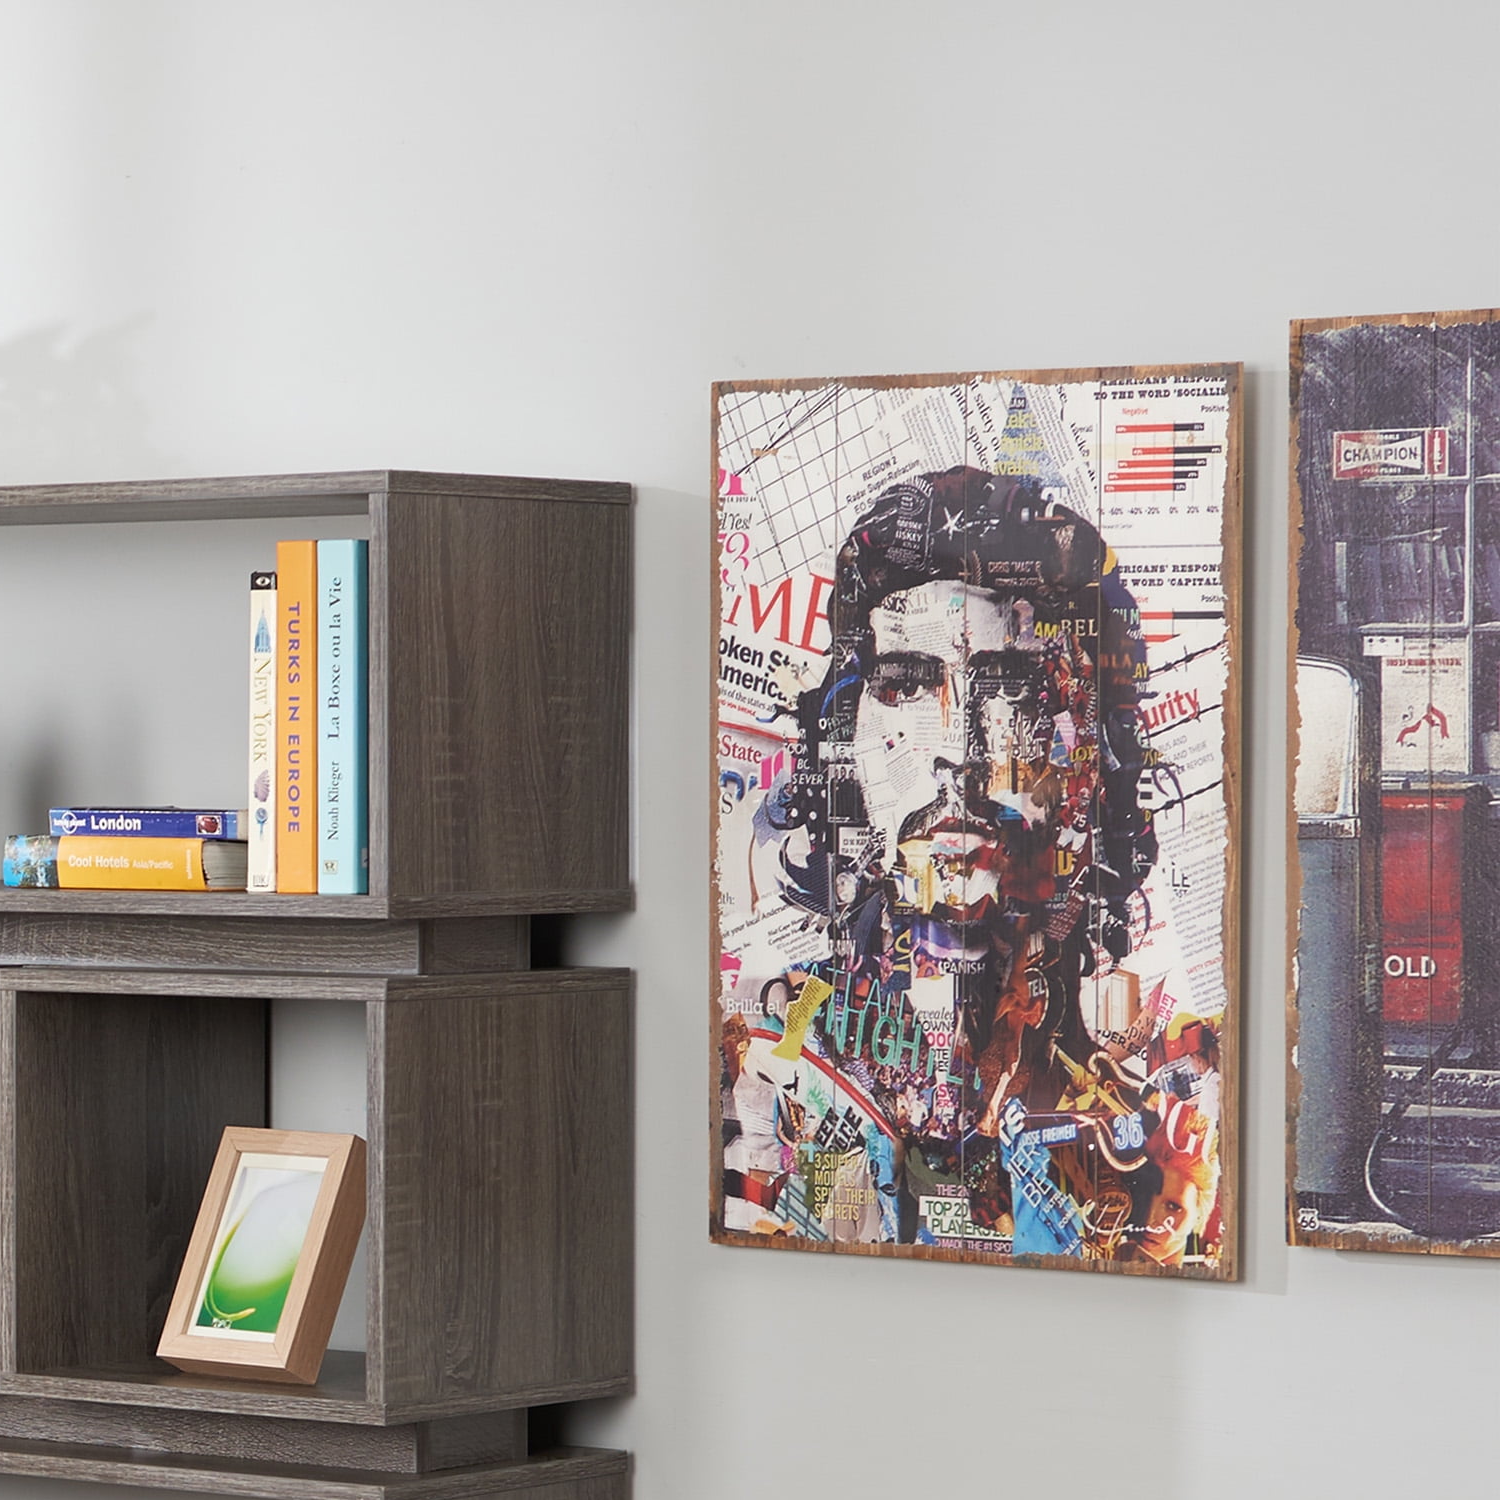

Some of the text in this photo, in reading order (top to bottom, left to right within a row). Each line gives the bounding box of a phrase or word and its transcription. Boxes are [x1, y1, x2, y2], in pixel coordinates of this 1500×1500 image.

[1093, 392, 1108, 400] TO
[1111, 391, 1134, 400] THE
[1138, 389, 1170, 398] WORD
[1343, 447, 1418, 462] CHAMPION
[862, 460, 891, 481] REGION
[1132, 578, 1164, 586] WORD
[328, 577, 342, 739] La Boxe ou la Vie
[253, 658, 272, 762] NEW YORK
[287, 602, 300, 832] TURKS IN EUROPE
[720, 734, 762, 764] State
[91, 815, 142, 830] London
[327, 807, 339, 840] Noah
[68, 855, 92, 867] Cool
[95, 856, 129, 868] Hotels
[1384, 955, 1436, 978] OLD
[1114, 1113, 1144, 1150] 36
[936, 1184, 956, 1196] THE
[925, 1200, 952, 1216] TOP
[1300, 1216, 1317, 1229] 66
